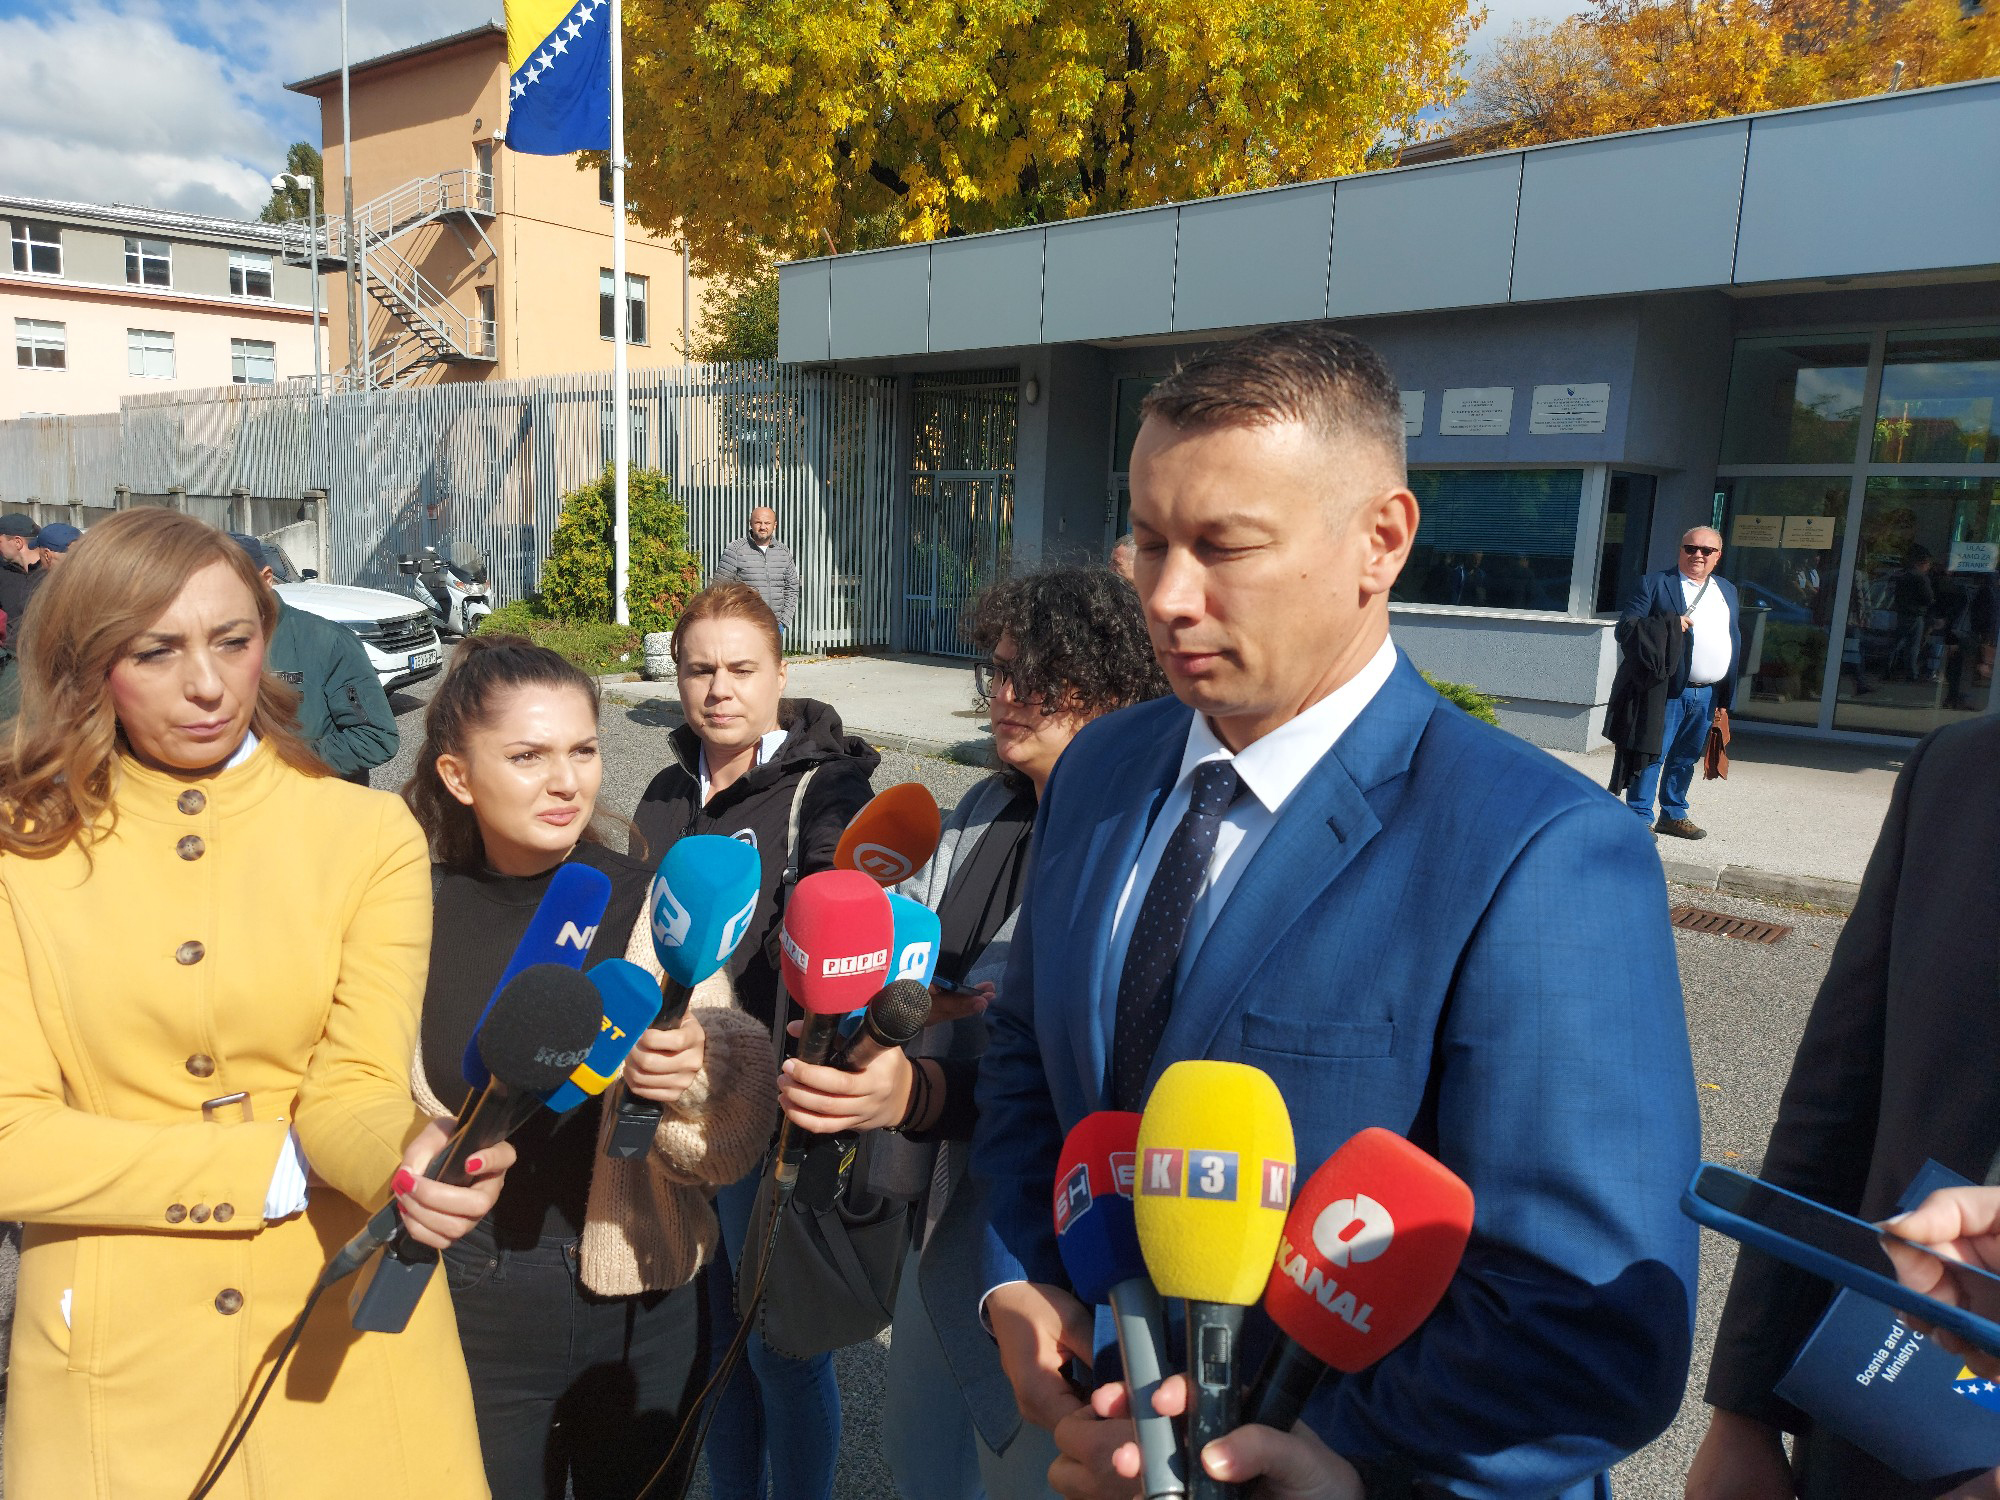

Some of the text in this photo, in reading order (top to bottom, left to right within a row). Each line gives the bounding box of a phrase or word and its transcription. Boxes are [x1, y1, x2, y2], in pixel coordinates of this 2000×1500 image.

[1276, 1235, 1374, 1334] KANAL
[1856, 1324, 1905, 1386] Bosnia and
[1881, 1338, 1920, 1383] Ministry
